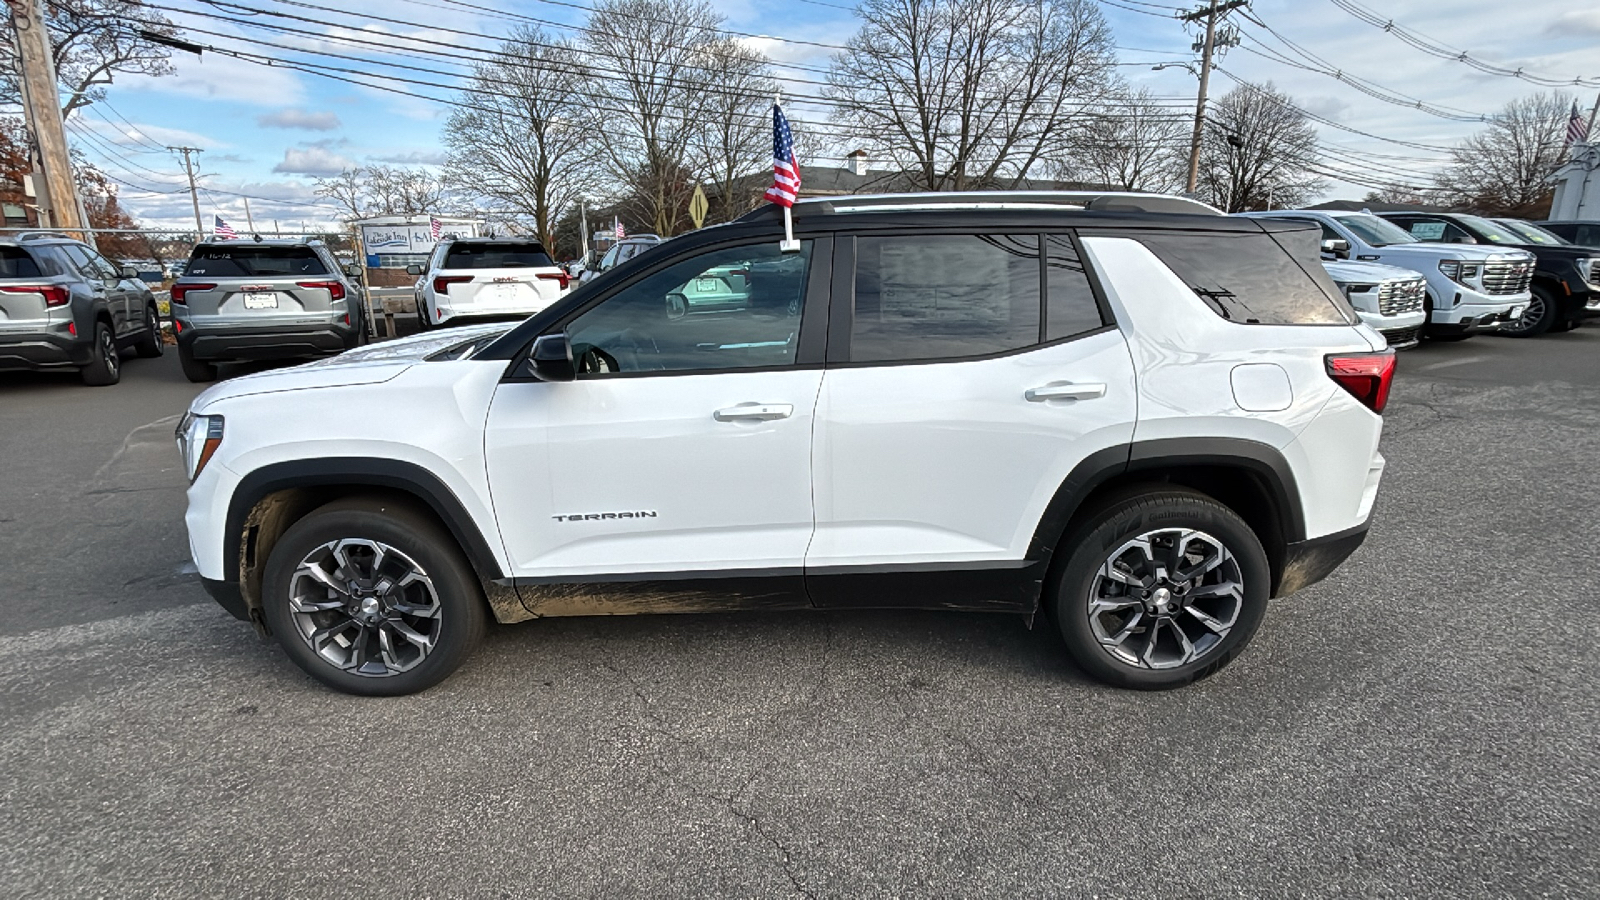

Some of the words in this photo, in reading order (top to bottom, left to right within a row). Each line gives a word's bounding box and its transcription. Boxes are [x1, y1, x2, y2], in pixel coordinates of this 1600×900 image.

[366, 232, 392, 244] Lakeside
[392, 231, 408, 242] Inn
[551, 511, 658, 523] TERRAIN
[1148, 510, 1199, 522] Continental
